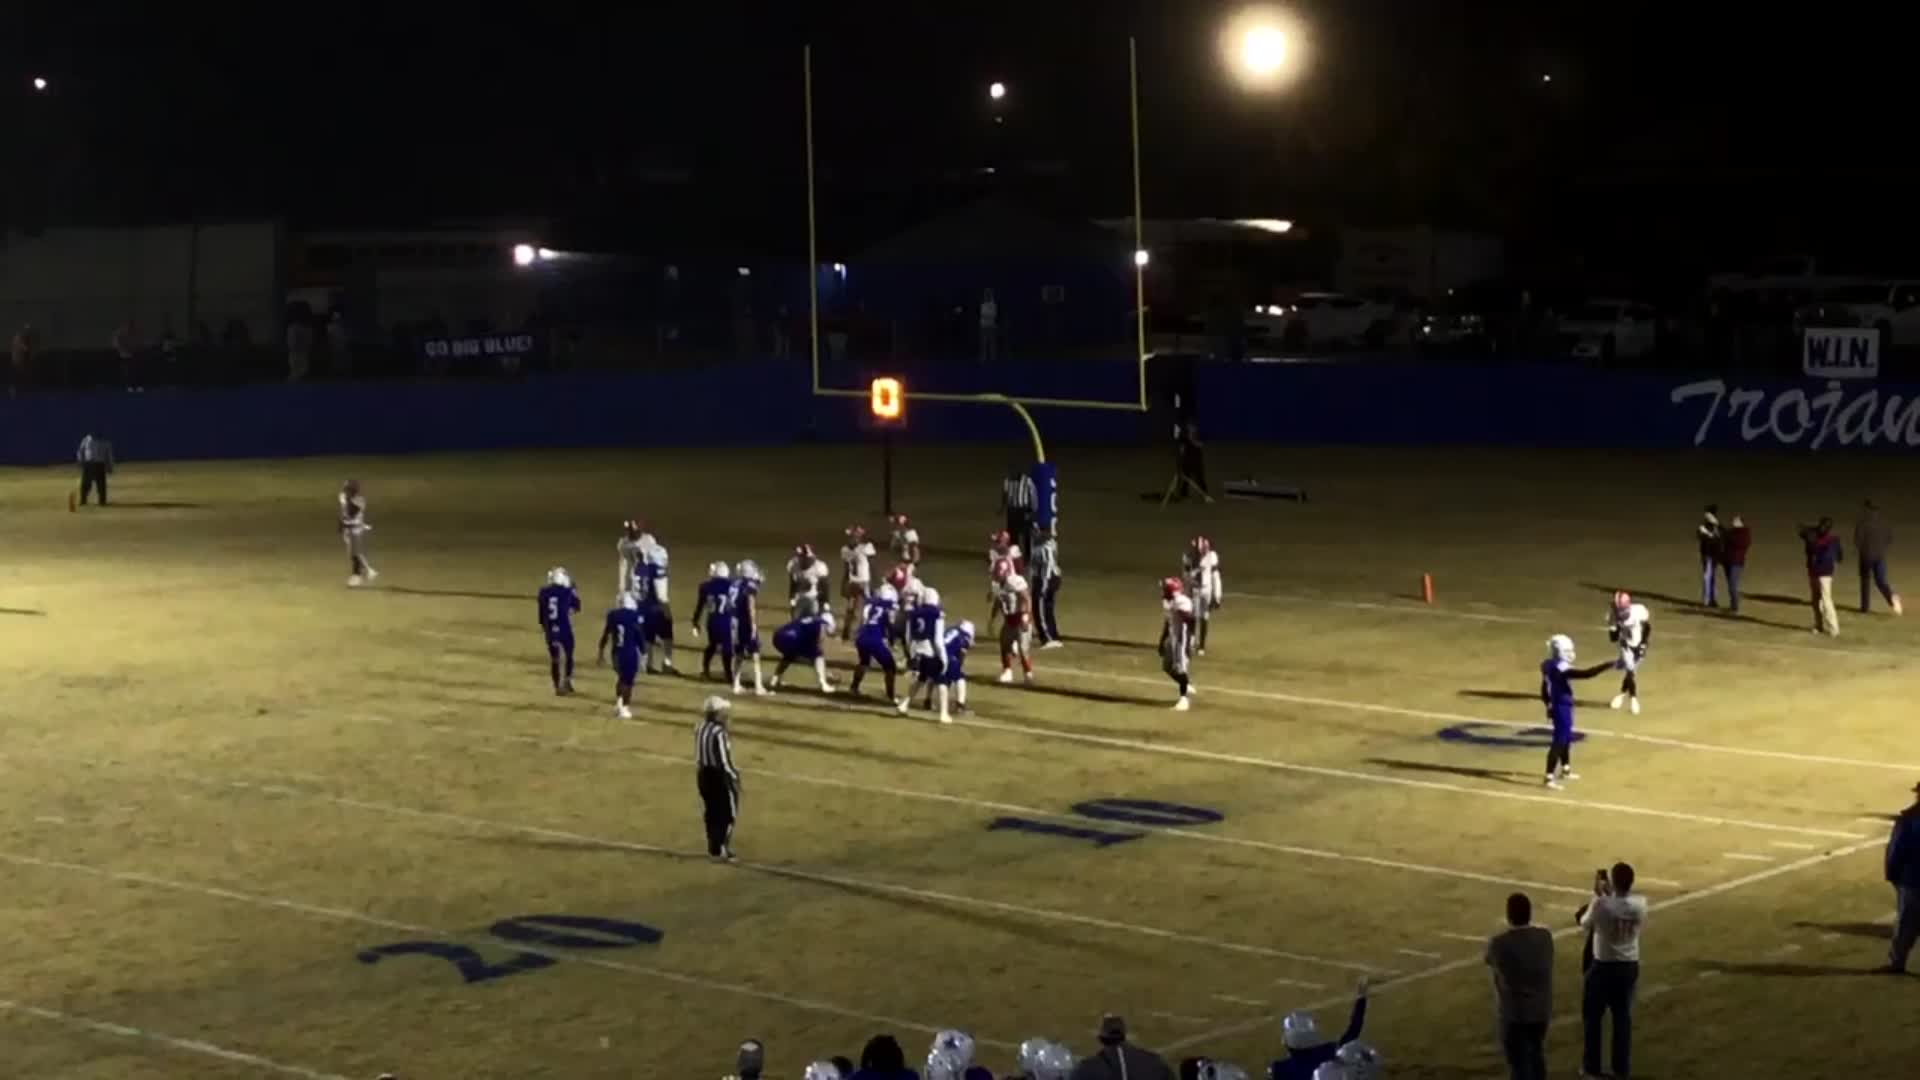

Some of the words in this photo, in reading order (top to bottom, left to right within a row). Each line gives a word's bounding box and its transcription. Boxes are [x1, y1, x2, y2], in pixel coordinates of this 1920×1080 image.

[1807, 335, 1875, 369] W.I.N.
[871, 377, 899, 417] 0
[548, 597, 559, 619] 5
[986, 798, 1225, 849] 10
[355, 914, 665, 983] 20
